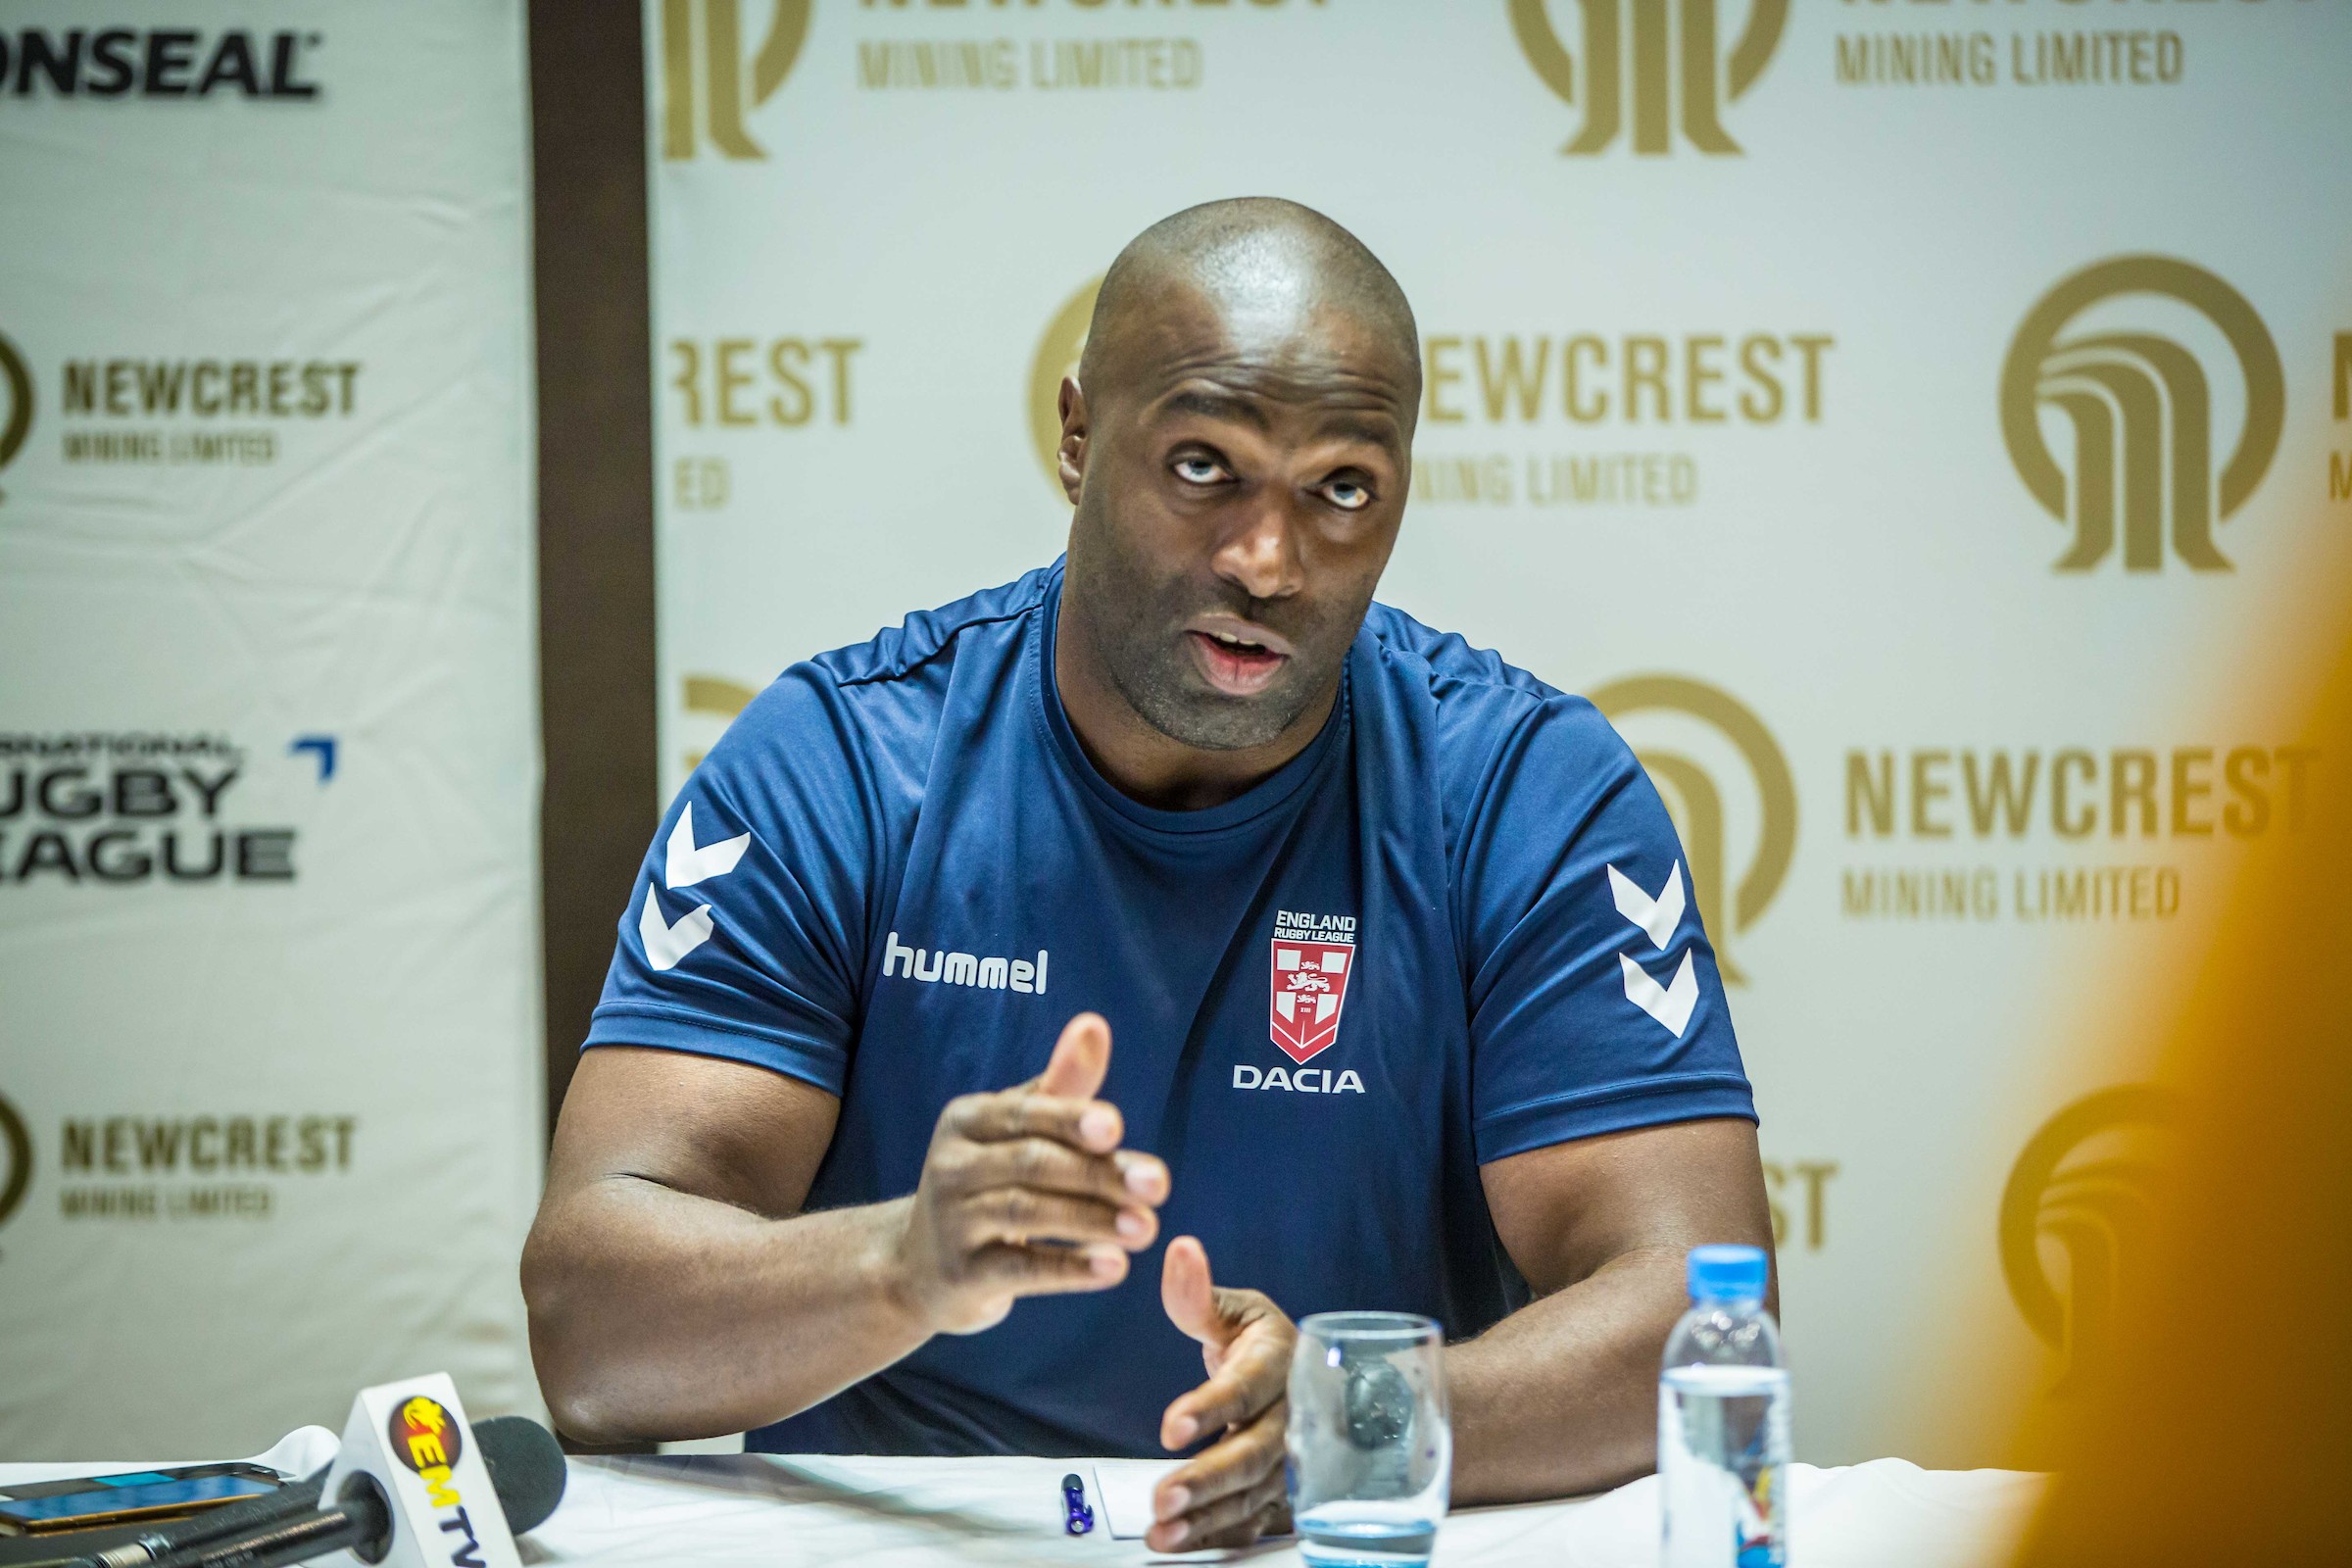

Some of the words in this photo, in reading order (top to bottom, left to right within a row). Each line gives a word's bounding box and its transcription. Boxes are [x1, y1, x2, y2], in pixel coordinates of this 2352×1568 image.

[0, 30, 320, 96] NSEAL
[858, 37, 1016, 90] MINING
[1030, 37, 1203, 90] LIMITED
[1836, 31, 1996, 86] MINING
[2010, 30, 2184, 86] LIMITED
[62, 359, 363, 418] NEWCREST
[1422, 333, 1835, 423] EWCREST
[1412, 455, 1512, 507] NING
[1526, 453, 1698, 507] LIMITED
[1843, 748, 2323, 842] NEWCREST
[0, 829, 298, 884] AGUE
[1842, 866, 1997, 919] MINING
[2015, 866, 2181, 919] LIMITED
[1274, 926, 1311, 941] RUGBY
[1311, 930, 1354, 943] LEAGUE
[1276, 909, 1356, 932] ENGLAND
[883, 931, 1049, 995] hummel
[1233, 1064, 1366, 1094] DACIA
[61, 1114, 357, 1173] NEWCREST
